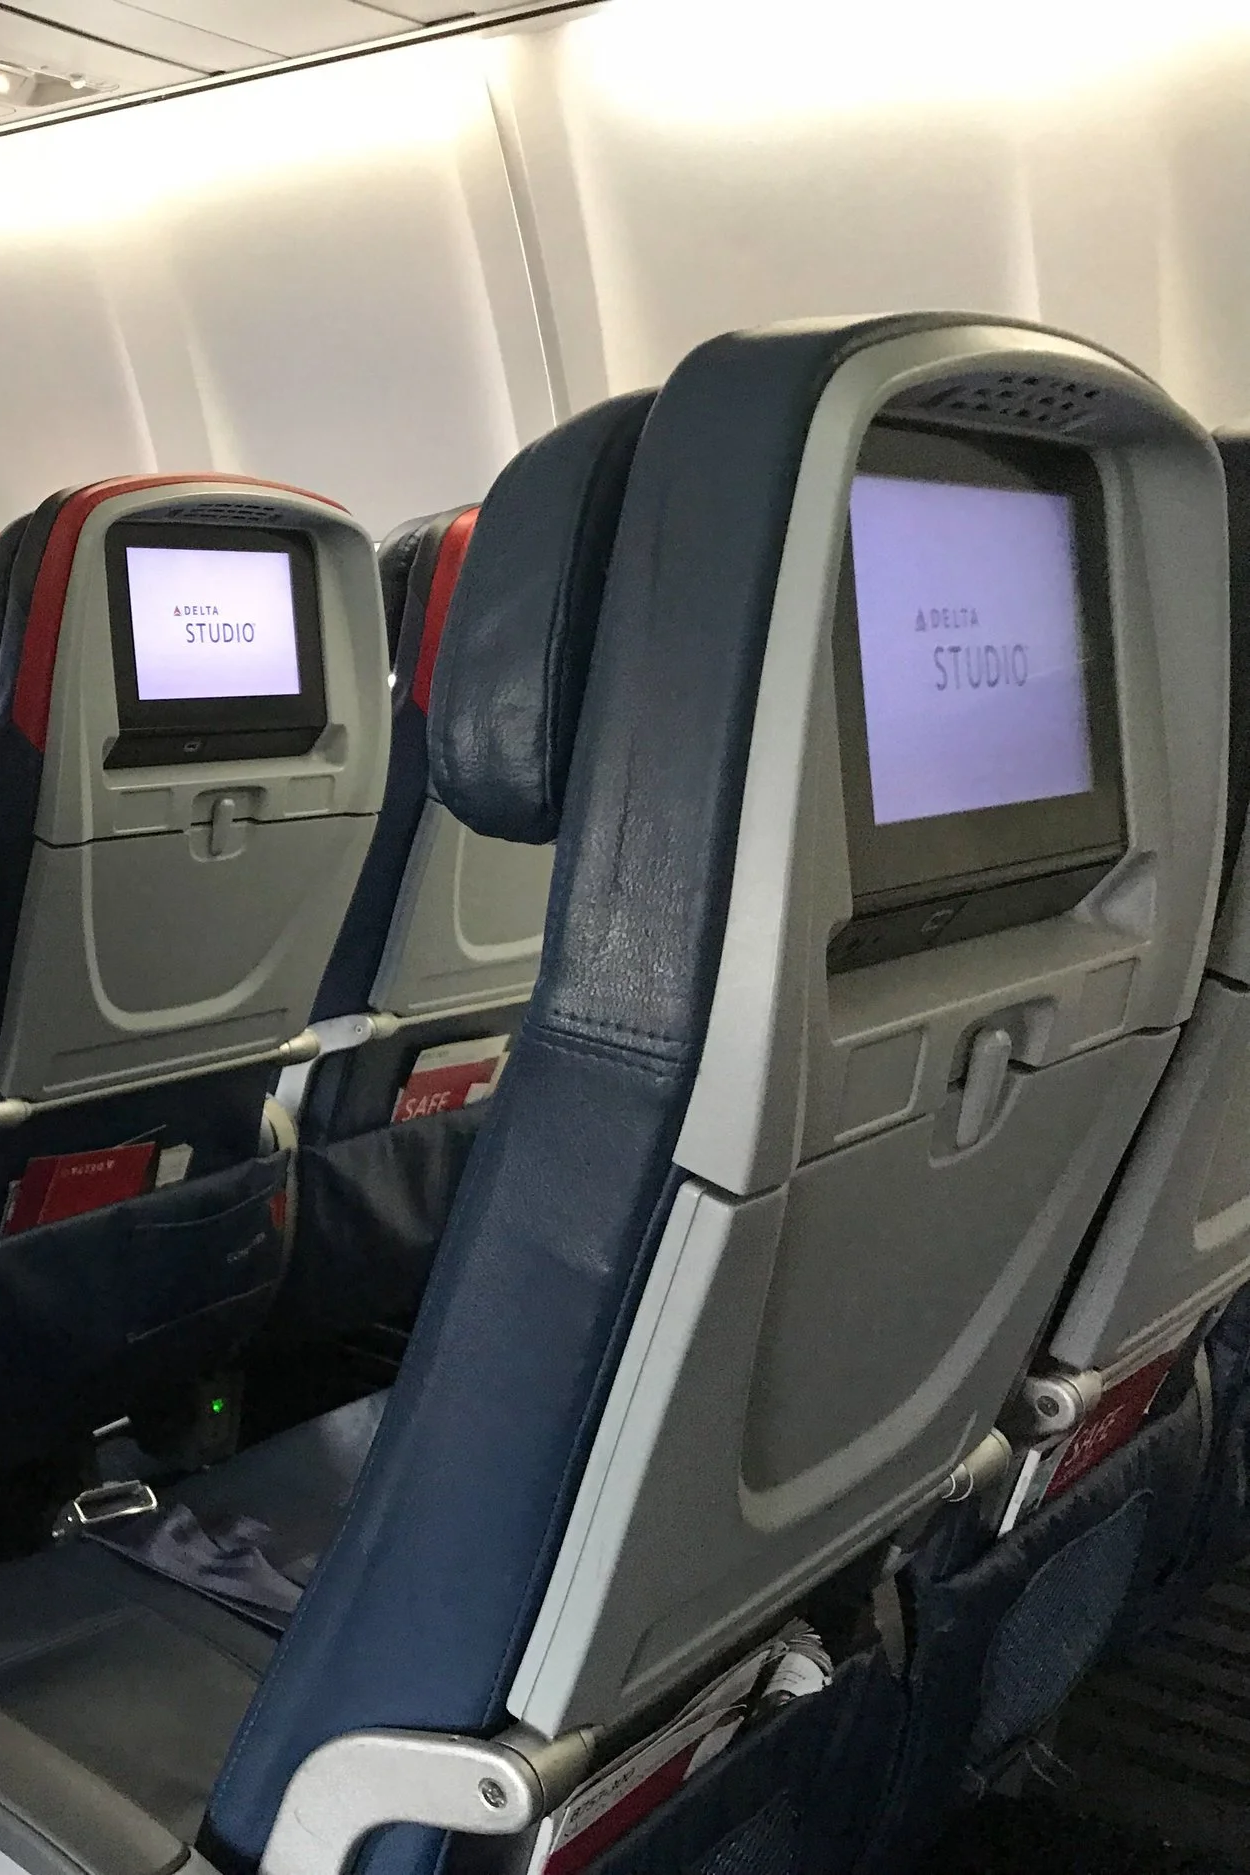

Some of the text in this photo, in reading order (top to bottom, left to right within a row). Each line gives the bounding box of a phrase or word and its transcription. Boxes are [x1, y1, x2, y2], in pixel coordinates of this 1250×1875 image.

[183, 605, 219, 616] DELTA
[930, 607, 980, 629] DELTA
[185, 622, 255, 644] STUDIO
[934, 644, 1029, 691] STUDIO
